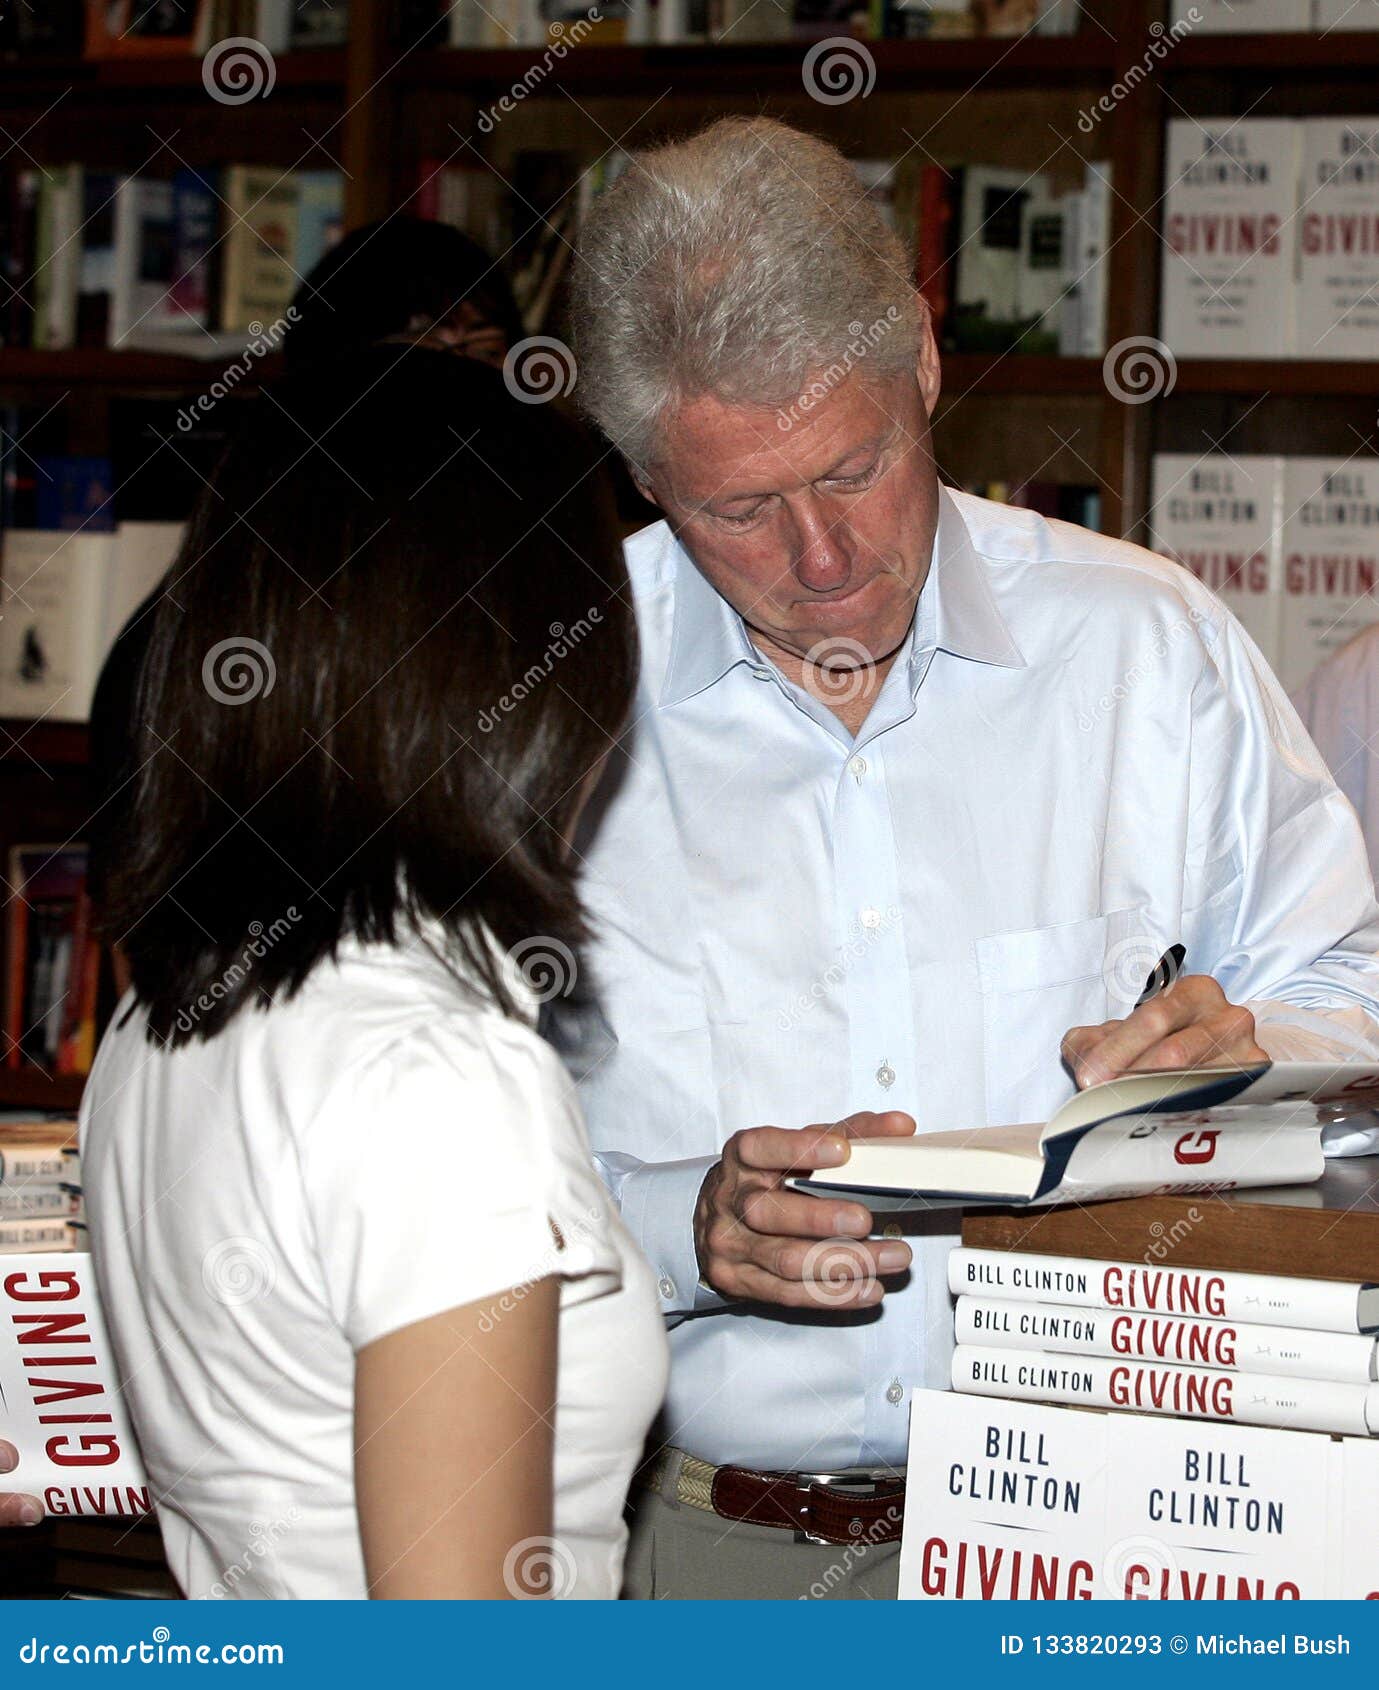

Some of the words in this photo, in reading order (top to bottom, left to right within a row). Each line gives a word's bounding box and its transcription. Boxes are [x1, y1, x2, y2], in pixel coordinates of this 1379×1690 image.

[1166, 213, 1281, 257] GIVING
[968, 1263, 1004, 1285] BILL
[1013, 1268, 1087, 1293] CLINTON
[1103, 1267, 1226, 1317] GIVING
[974, 1310, 1011, 1333] BILL
[1020, 1315, 1096, 1341] CLINTON
[1111, 1316, 1237, 1366] GIVING
[4, 1271, 121, 1467] GIVING
[972, 1361, 1009, 1384] BILL
[1018, 1366, 1093, 1393] CLINTON
[1109, 1366, 1233, 1417] GIVING
[985, 1426, 1050, 1466] BILL
[1185, 1449, 1251, 1488] BILL
[949, 1463, 1081, 1514] CLINTON
[1148, 1489, 1284, 1535] CLINTON
